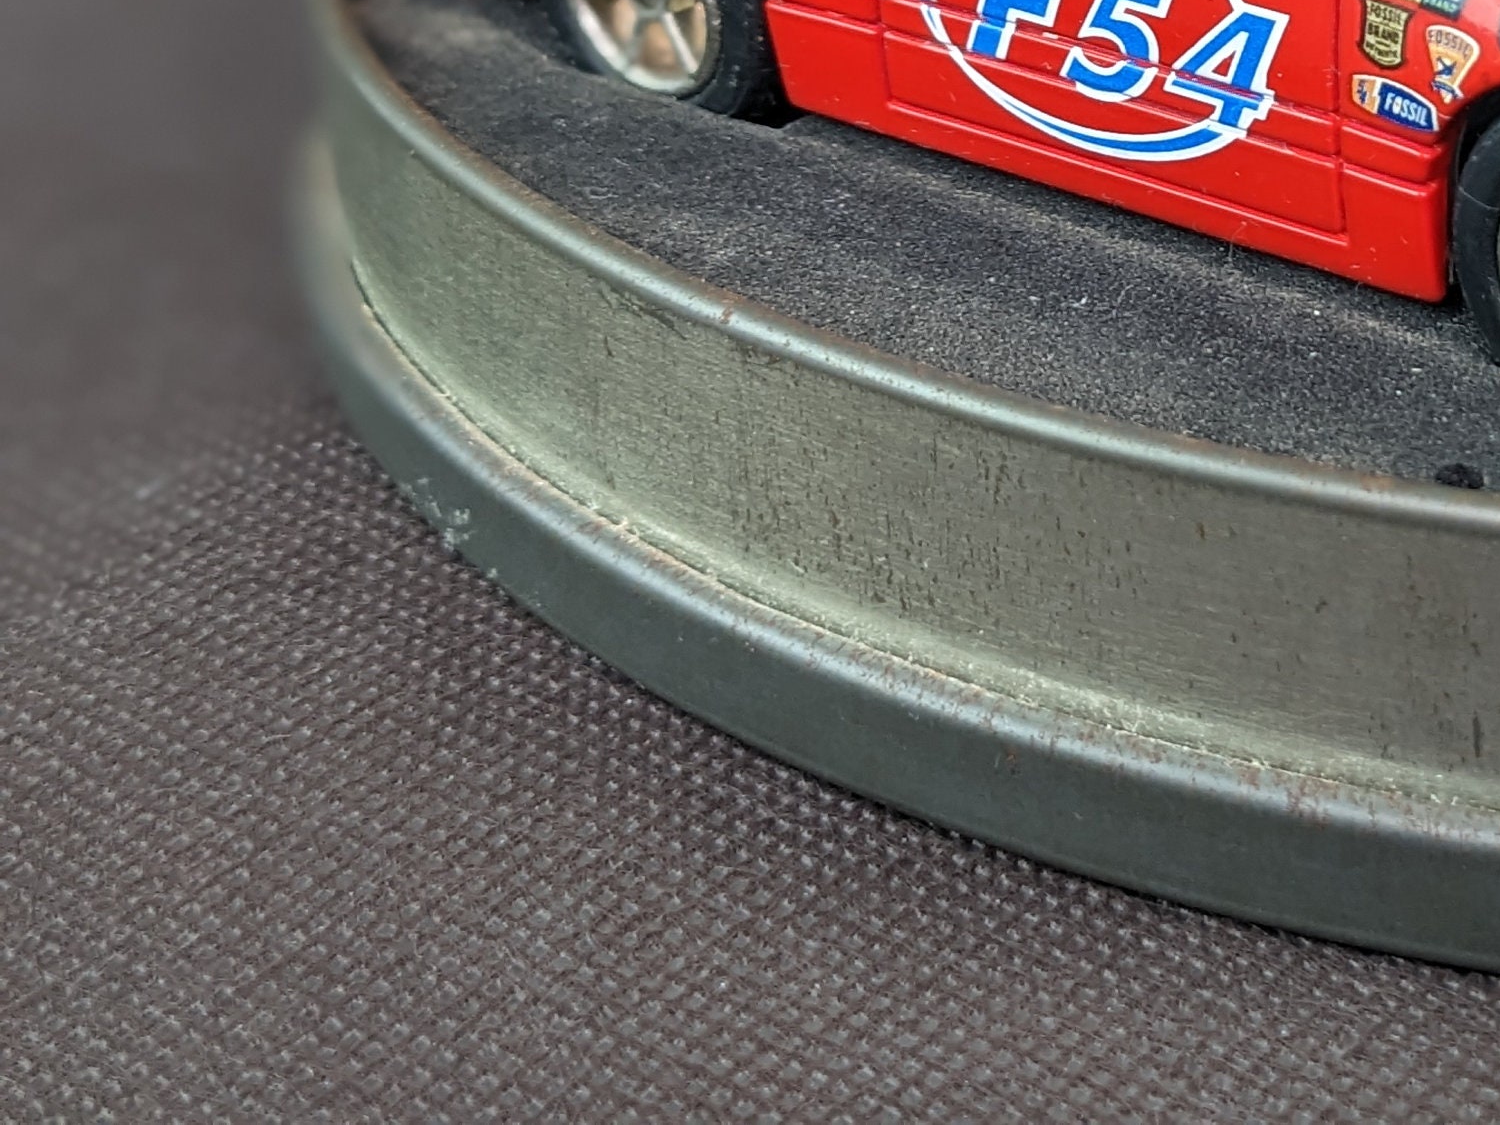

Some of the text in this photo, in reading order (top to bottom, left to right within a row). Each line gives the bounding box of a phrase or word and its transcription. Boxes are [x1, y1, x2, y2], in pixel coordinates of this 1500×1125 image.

[1368, 2, 1402, 25] FOSSIL
[1427, 28, 1471, 61] FOSSIL
[1383, 91, 1430, 127] FOSSIL
